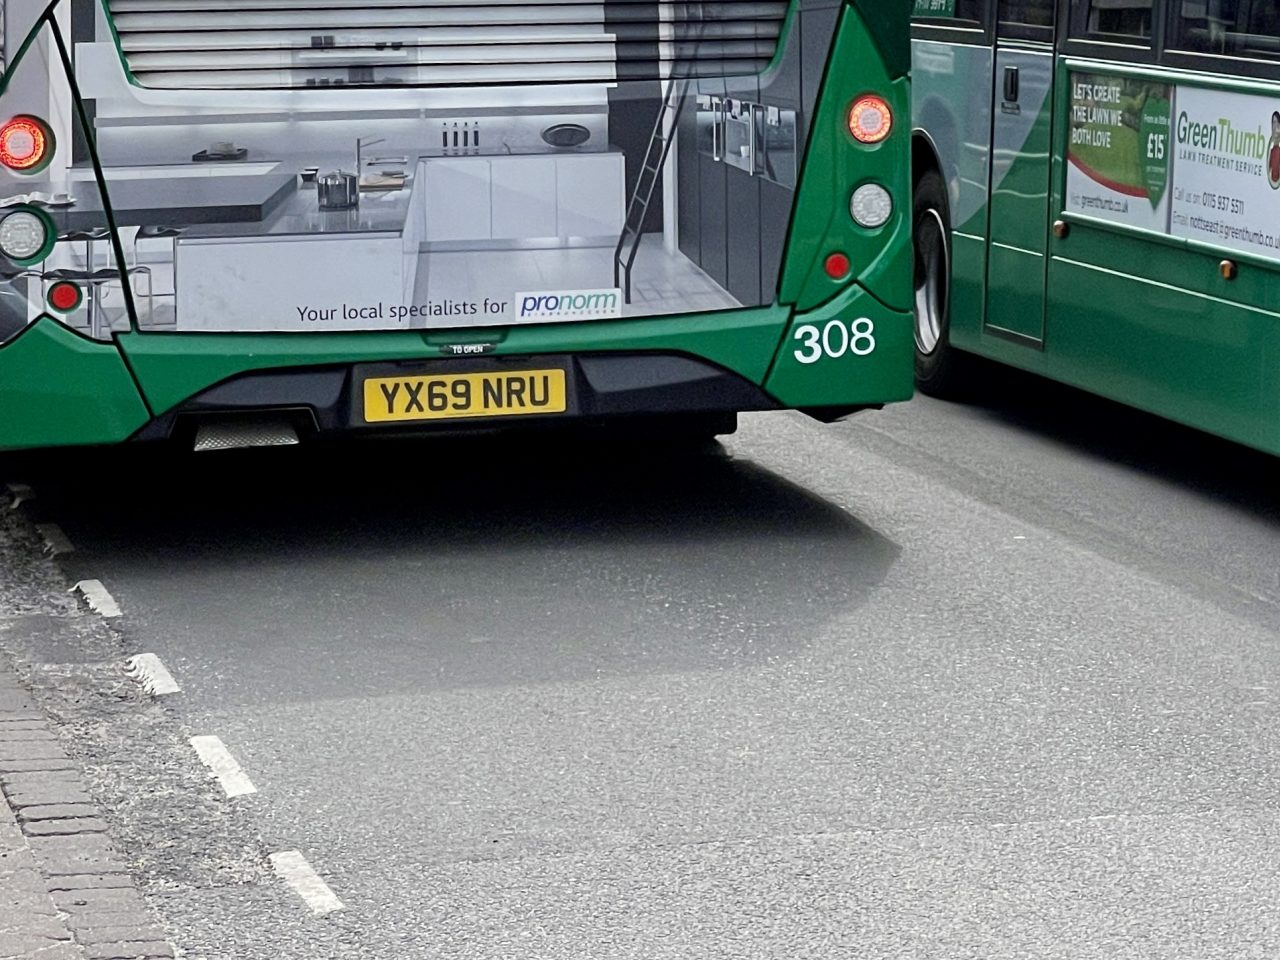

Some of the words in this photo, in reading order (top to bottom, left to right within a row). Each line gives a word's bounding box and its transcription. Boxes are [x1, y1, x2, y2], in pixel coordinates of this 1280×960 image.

[1093, 85, 1120, 103] CREATE
[1073, 105, 1086, 123] THE
[1087, 107, 1109, 125] LAWN
[1110, 110, 1122, 127] WE
[1072, 127, 1091, 145] BOTH
[1093, 130, 1111, 148] LOVE
[1177, 110, 1265, 159] GreenThumb
[1179, 149, 1196, 162] LAWN
[1198, 152, 1234, 171] TREATMENT
[1235, 160, 1262, 176] SERVICE
[297, 305, 337, 322] Your
[342, 303, 382, 320] local
[389, 299, 477, 322] specialists
[483, 298, 507, 315] for
[521, 293, 616, 316] pronorm
[452, 346, 463, 354] TO
[464, 345, 483, 353] OPEN
[793, 316, 876, 365] 308
[380, 378, 471, 414] YX69
[483, 375, 549, 409] NRU
